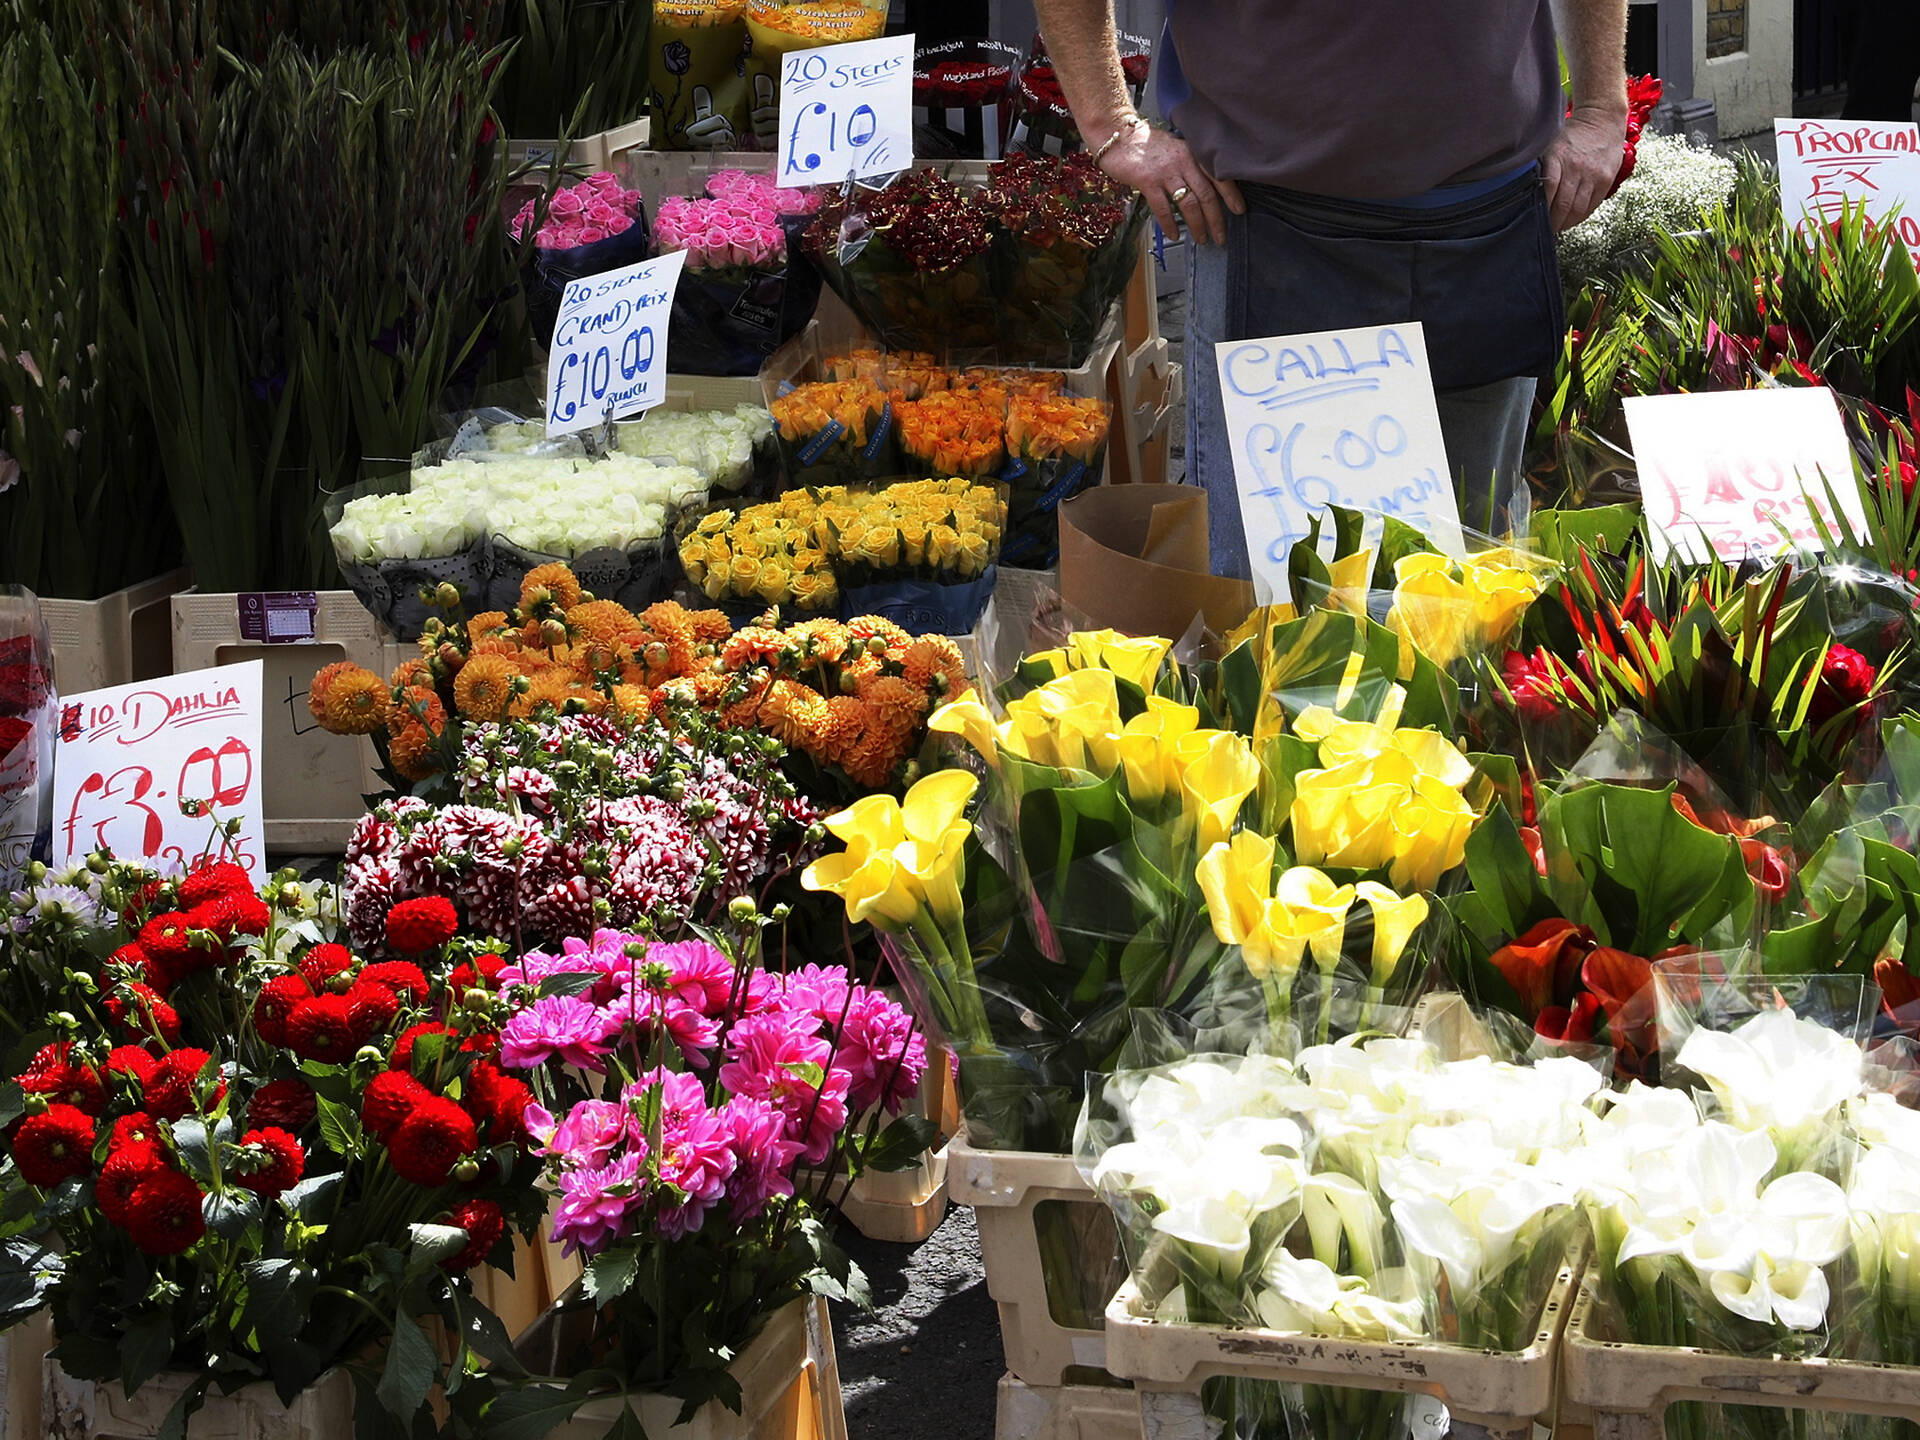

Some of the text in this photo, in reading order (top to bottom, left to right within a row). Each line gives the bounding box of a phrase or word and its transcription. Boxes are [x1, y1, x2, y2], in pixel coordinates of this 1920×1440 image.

[784, 55, 904, 88] 20 STEMS
[785, 101, 876, 175] £10
[1806, 167, 1880, 200] EX
[563, 266, 656, 308] 20 STEMS
[550, 326, 654, 424] £10.00
[1224, 329, 1415, 397] CALLA
[61, 736, 252, 862] £3.00
